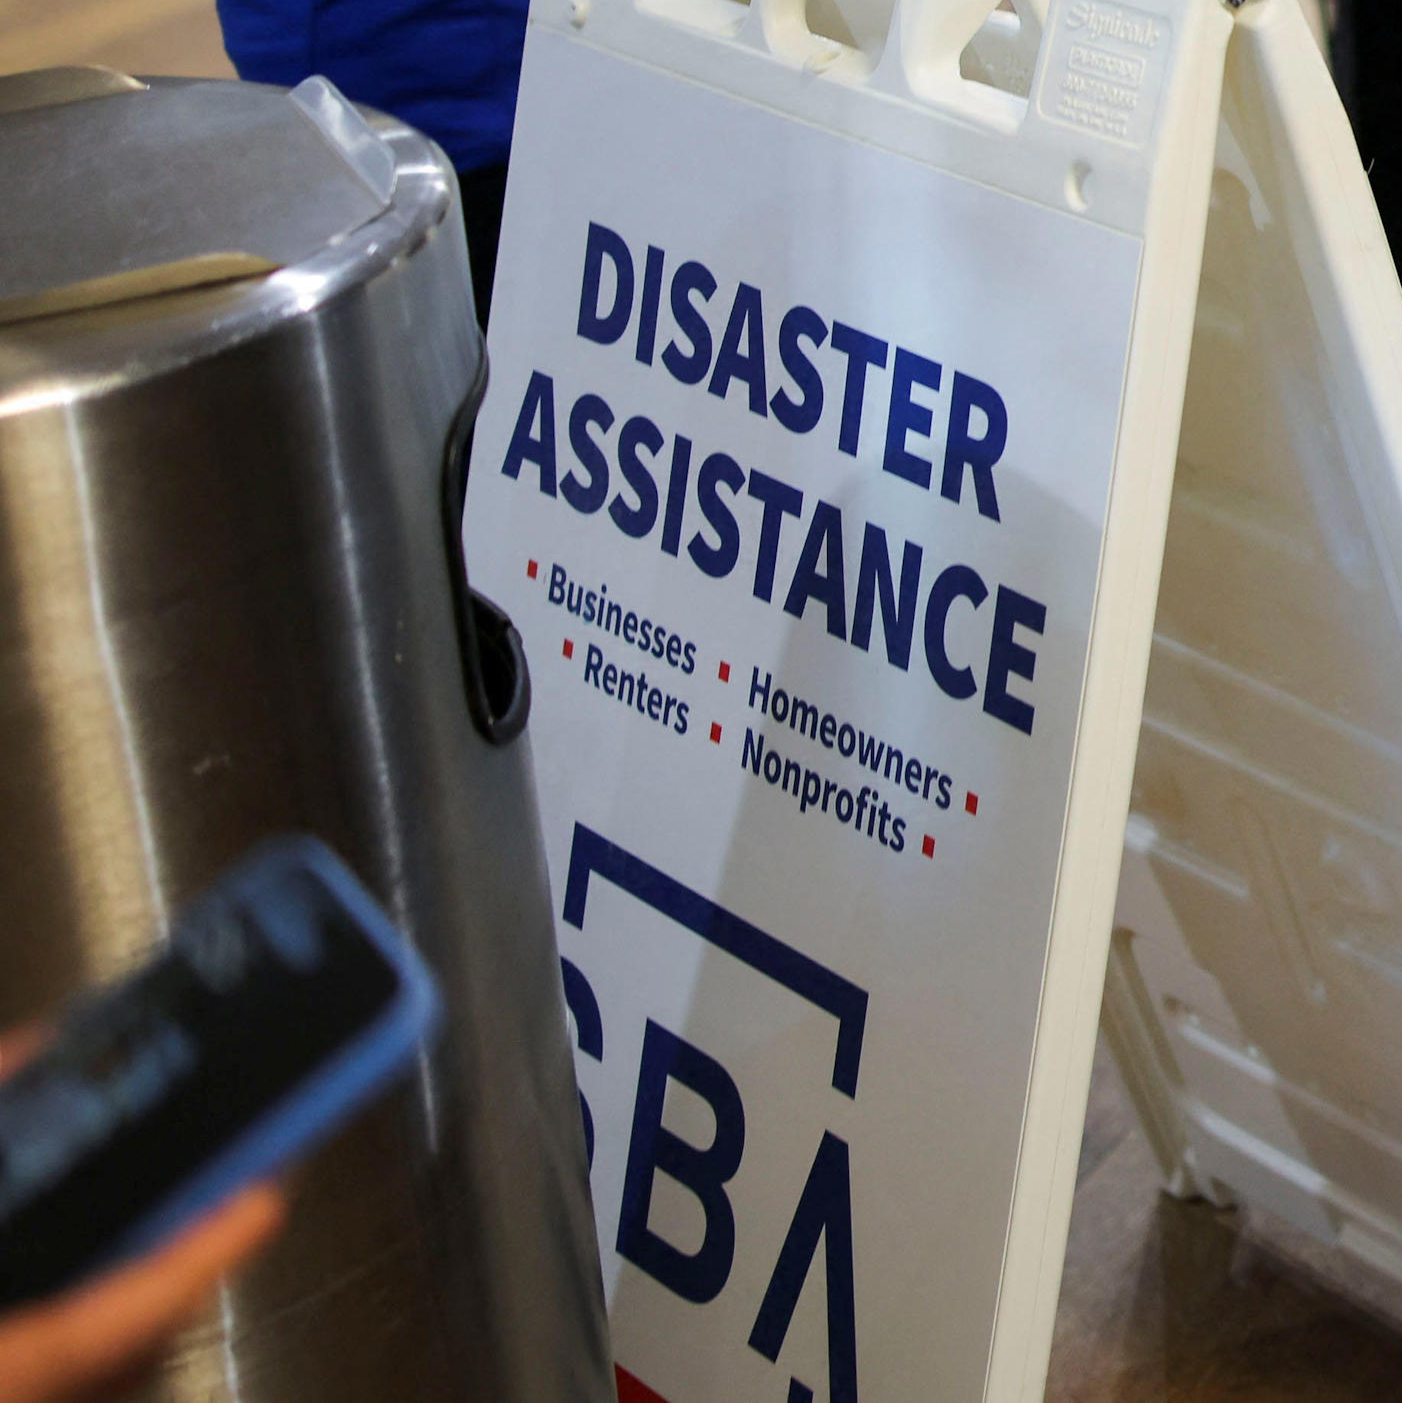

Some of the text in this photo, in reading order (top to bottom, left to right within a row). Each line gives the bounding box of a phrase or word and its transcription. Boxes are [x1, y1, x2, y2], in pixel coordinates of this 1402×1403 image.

[577, 221, 1008, 523] DISASTER
[501, 370, 1047, 735] ASSISTANCE
[548, 563, 953, 810] Businesses Homeowners
[583, 643, 907, 854] Renters Nonprofits
